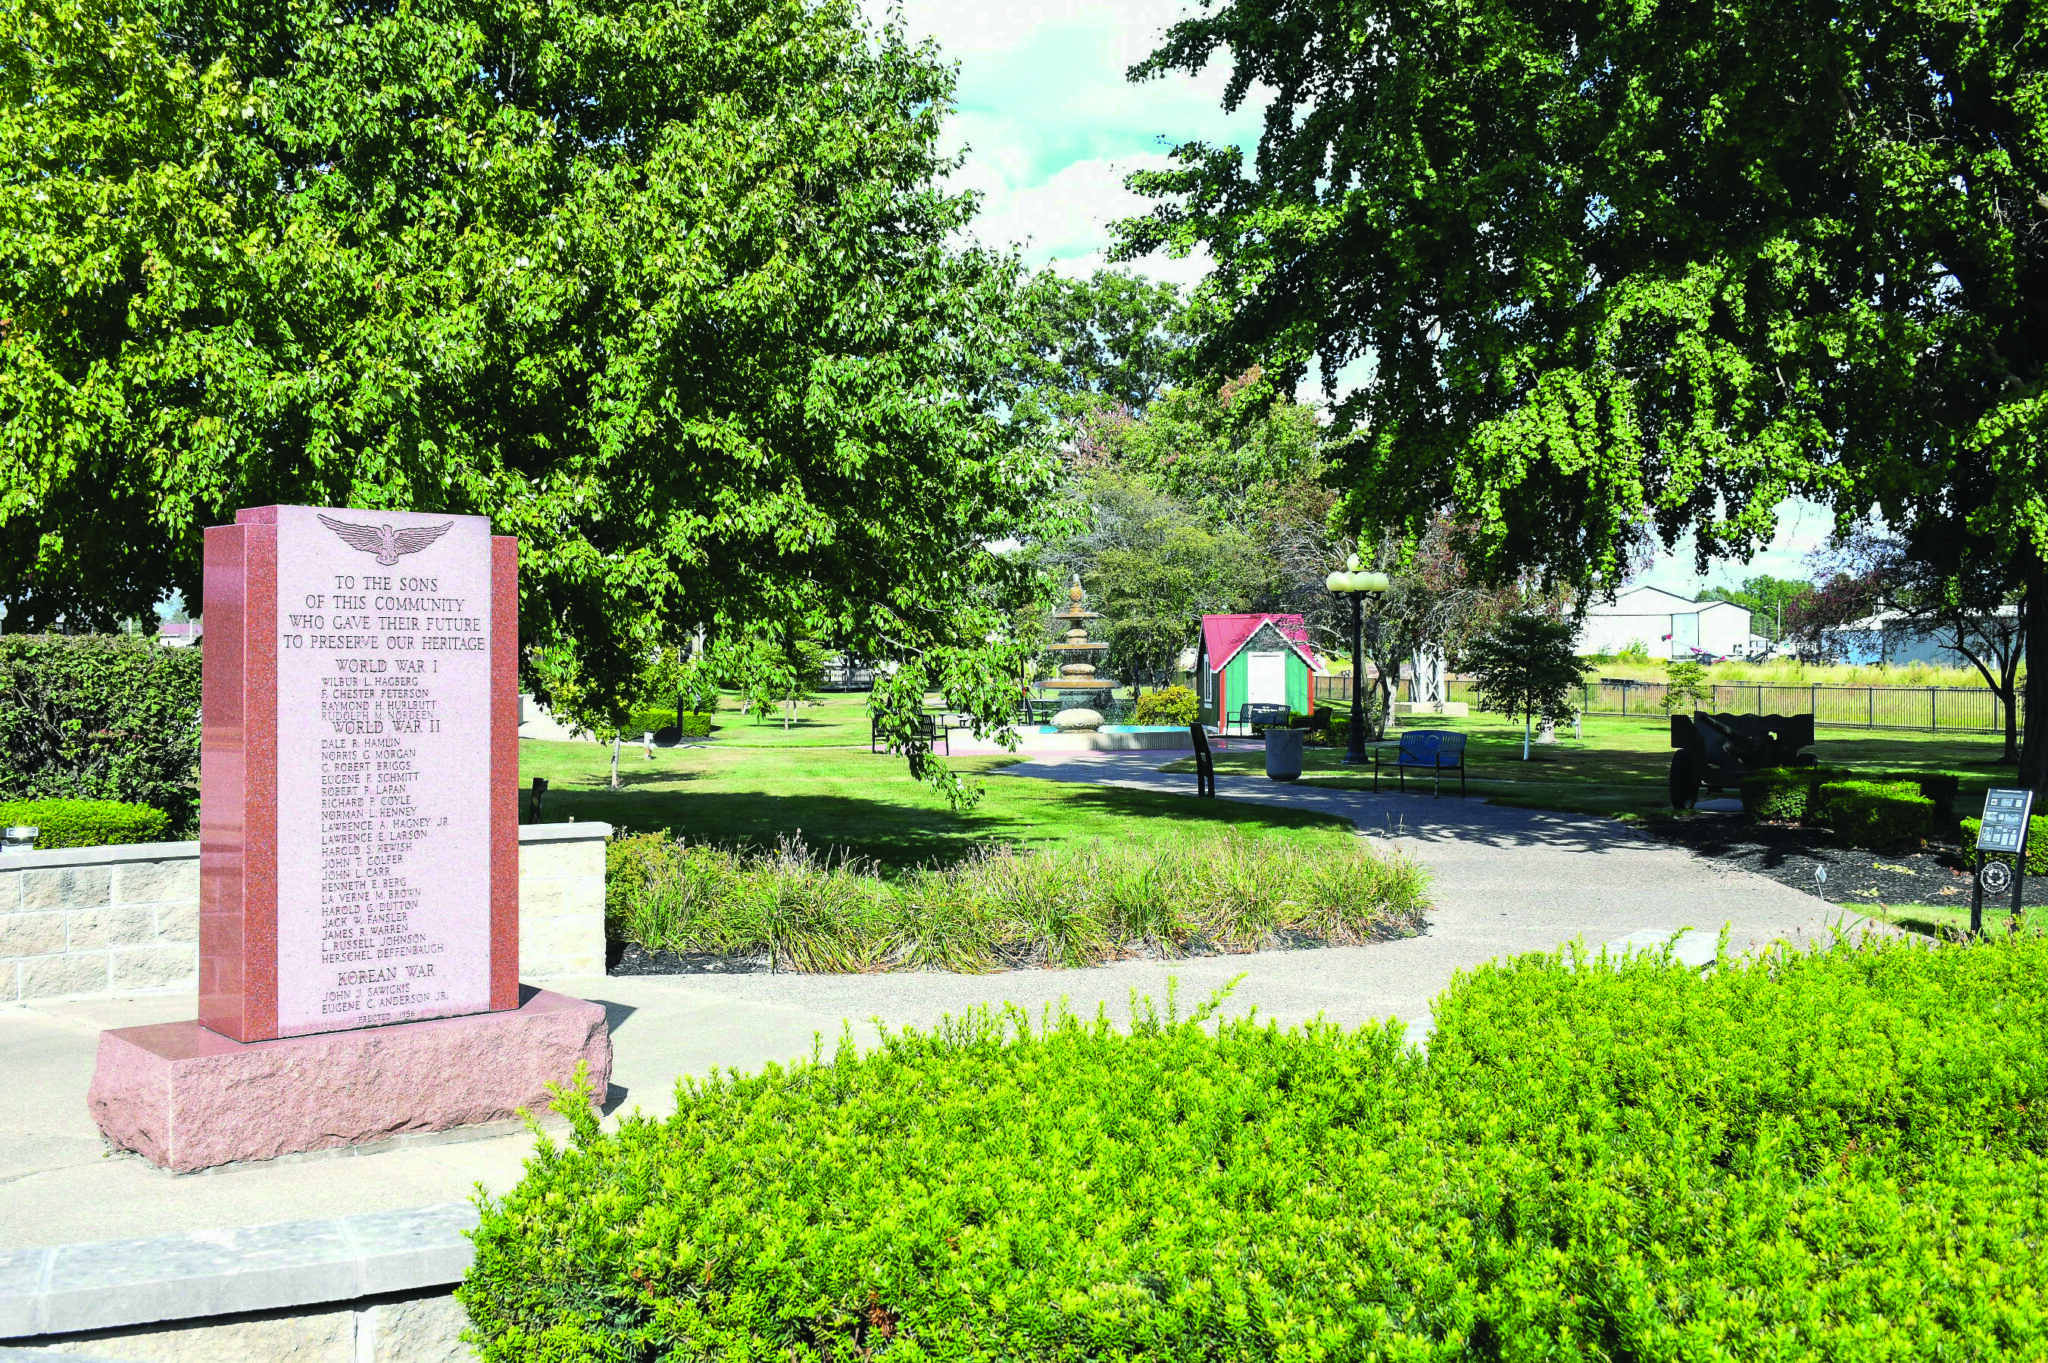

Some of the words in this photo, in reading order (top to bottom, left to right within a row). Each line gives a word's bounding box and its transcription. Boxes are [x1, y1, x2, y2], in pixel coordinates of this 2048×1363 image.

[335, 576, 354, 589] TO
[363, 577, 391, 590] THE
[400, 578, 438, 591] SONS
[306, 595, 324, 608] OF
[333, 596, 366, 609] THIS
[375, 597, 464, 611] COMMUNITY
[289, 615, 324, 629] WHO
[333, 616, 370, 629] GAVE
[378, 617, 420, 630] THEIR
[426, 618, 480, 631] FUTURE
[284, 635, 302, 648] TO
[311, 636, 378, 649] PRESERVE
[387, 637, 414, 649] OUR
[423, 637, 485, 650] HERITAGE
[336, 659, 387, 673] WORLD
[395, 660, 425, 673] WAR
[433, 660, 437, 673] I
[322, 677, 358, 686] WILBUR
[364, 677, 372, 686] L.
[375, 677, 418, 686] HAGBERG
[333, 690, 375, 699] CHESTER
[381, 689, 428, 698] PETERSON
[322, 702, 369, 711] RAYMOND
[388, 701, 436, 710] HURLBUTT
[322, 712, 368, 720] RUDOLPH
[388, 711, 433, 720] NORDEEN
[333, 721, 383, 734] WORLD
[392, 720, 423, 733] WAR
[430, 720, 440, 732] II
[322, 740, 346, 749] DALE
[365, 738, 400, 747] HAMLIN
[322, 750, 357, 760] NORRIS
[376, 749, 416, 759] MORGAN
[335, 762, 371, 772] ROBERT
[377, 761, 411, 771] BRIGGS
[322, 774, 360, 784] EUGENE
[378, 772, 420, 783] SCHMITT
[322, 787, 358, 797] ROBERT
[322, 798, 363, 808] RICHARD
[381, 796, 411, 806] COYLE
[322, 810, 363, 820] NORMAN
[369, 809, 377, 818] L.
[380, 807, 417, 817] KENNEY
[322, 821, 373, 832] LAWRENCE
[380, 821, 388, 829] A.
[394, 818, 431, 828] HAGNEY
[322, 833, 373, 845] LAWRENCE
[391, 830, 428, 840] LARSON
[322, 846, 360, 857] HAROLD
[322, 858, 350, 869] JOHN
[367, 855, 403, 865] COLFER
[322, 870, 350, 880] JOHN
[356, 869, 363, 878] L.
[366, 867, 390, 877] CARR
[322, 881, 366, 892] KENNETH
[383, 878, 406, 888] BERG
[322, 895, 333, 904] LA
[339, 892, 370, 902] VERNE
[389, 888, 421, 899] BROWN
[322, 905, 360, 917] HAROLD
[380, 901, 418, 912] DUTTON
[322, 918, 347, 929] JACK
[368, 913, 407, 924] FANSLER
[322, 929, 353, 940] JAMES
[371, 924, 408, 934] WARREN
[322, 943, 330, 952] L.
[334, 939, 375, 951] RUSSELL
[380, 934, 426, 947] JOHNSON
[322, 951, 373, 964] HERSCHEL
[377, 944, 444, 958] DEFFENBAUGH
[338, 967, 397, 986] KOREAN
[405, 964, 435, 978] WAR
[322, 991, 350, 1002] JOHN
[368, 983, 410, 997] SAWICKIS
[322, 1001, 360, 1014] EUGENE
[379, 993, 430, 1007] ANDERSON
[435, 991, 448, 1000] JR.
[358, 1013, 390, 1024] ERECTED
